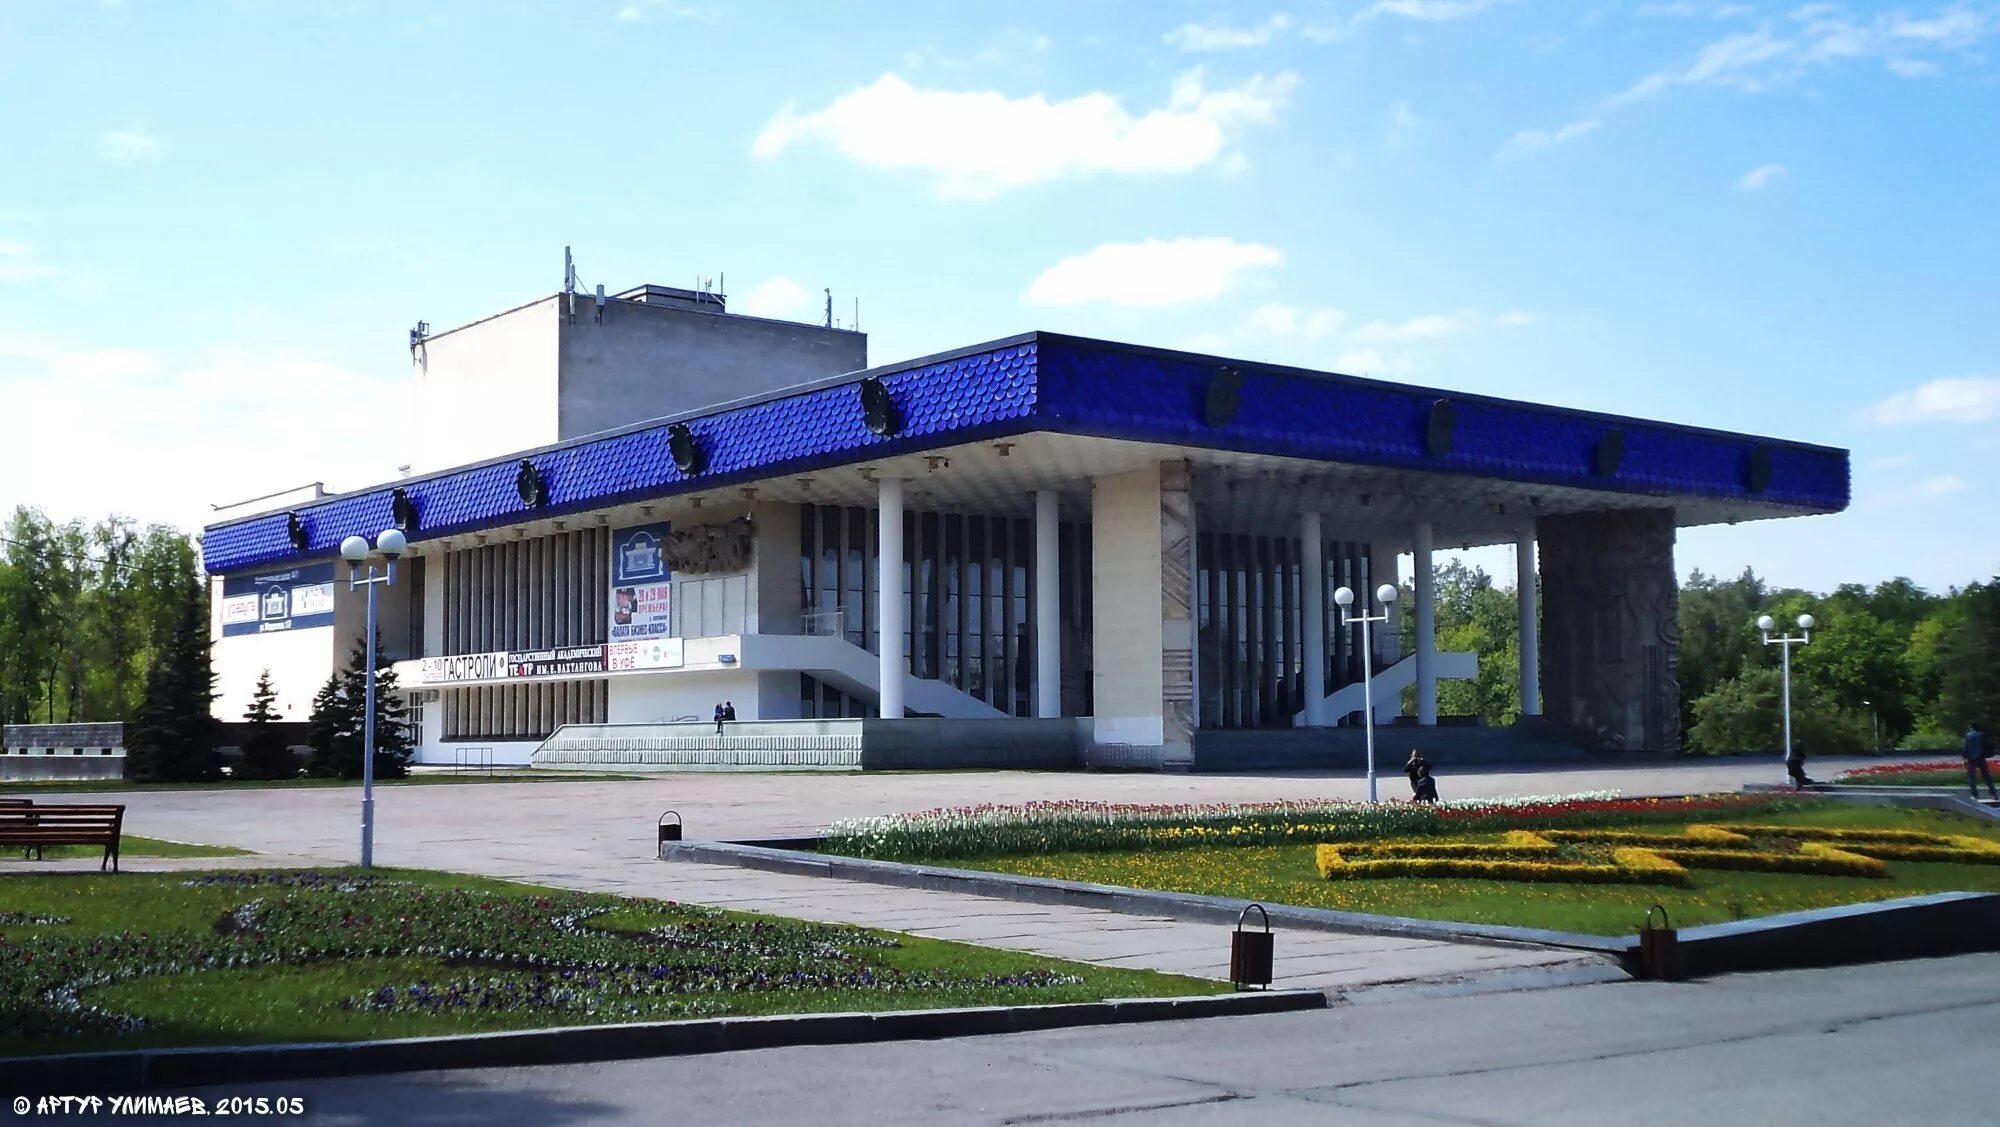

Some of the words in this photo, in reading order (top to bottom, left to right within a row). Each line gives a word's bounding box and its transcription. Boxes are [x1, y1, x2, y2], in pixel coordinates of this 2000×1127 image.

[509, 649, 556, 664] ГОСУДАРСТВЕННЫЙ
[557, 645, 602, 661] АКАДЕМИЧЕСКИЙ
[609, 643, 638, 656] ВПЕРВЫЕ
[422, 659, 427, 672] 2
[434, 659, 443, 671] 10
[443, 654, 497, 681] ГАСТРОЛИ
[508, 663, 534, 677] ТЕАТР
[612, 657, 617, 670] В
[619, 656, 635, 669] УФЕ
